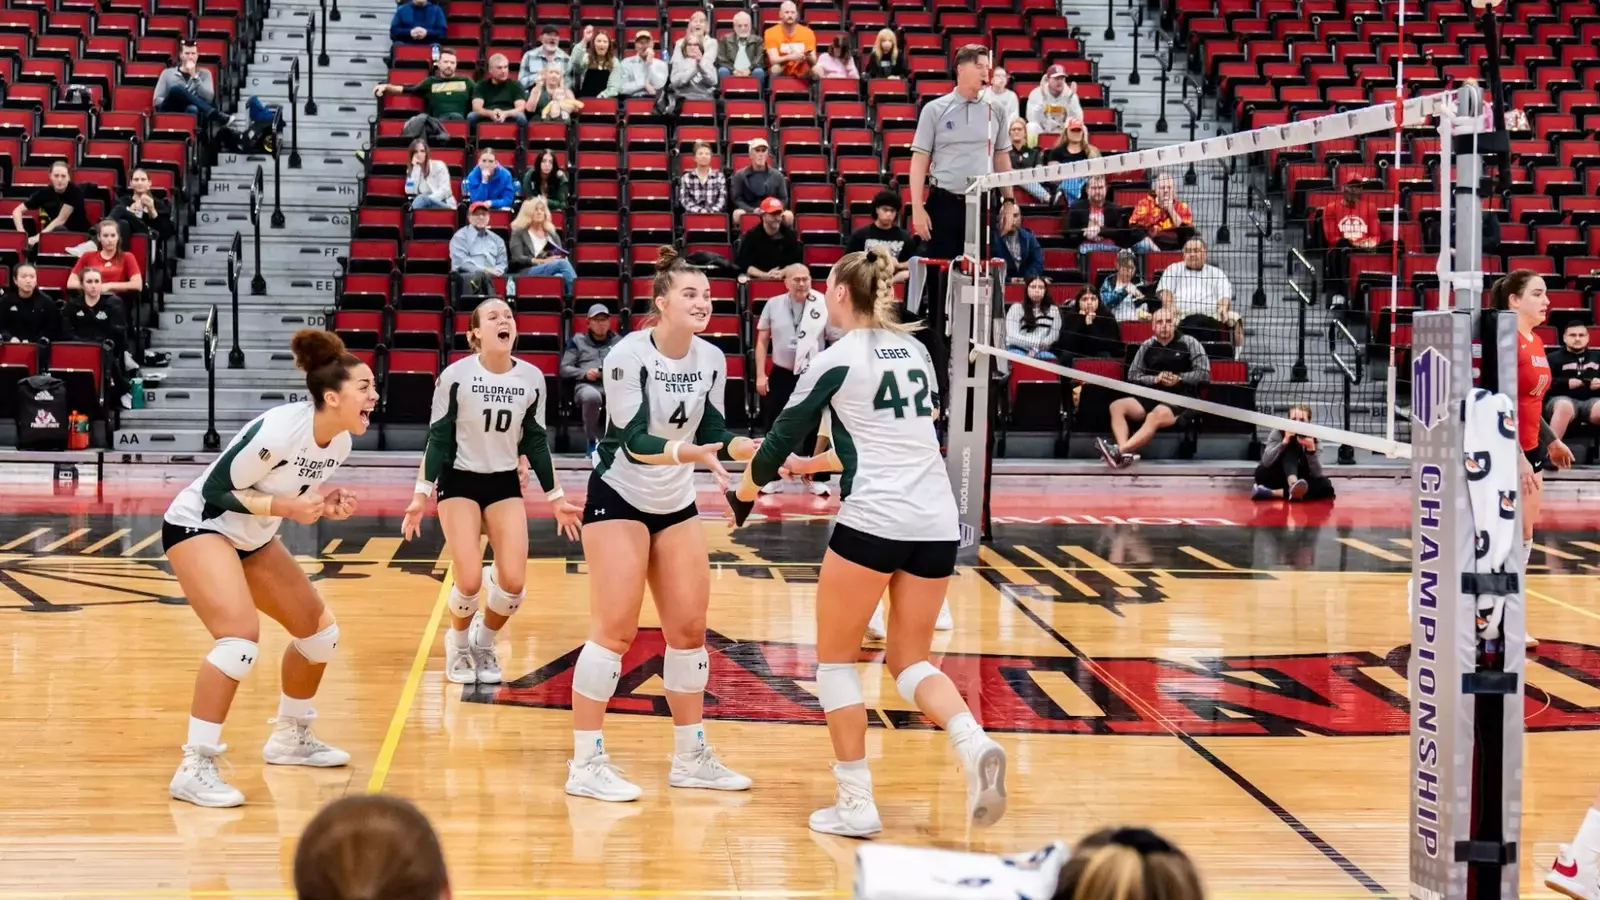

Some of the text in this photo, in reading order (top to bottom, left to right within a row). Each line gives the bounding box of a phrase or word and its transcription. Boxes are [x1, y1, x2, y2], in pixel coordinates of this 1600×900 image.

[213, 183, 230, 192] HH
[331, 215, 350, 225] GG
[193, 245, 209, 254] FF
[324, 247, 339, 257] FF
[180, 278, 197, 289] EE
[315, 280, 333, 291] EE
[307, 316, 326, 327] DD
[874, 347, 912, 360] LEBER
[471, 384, 525, 396] COLORADO
[872, 368, 933, 420] 42
[483, 394, 514, 404] STATE
[668, 400, 689, 429] 4
[482, 408, 513, 433] 10
[119, 433, 140, 445] AA
[961, 447, 971, 477] sports
[1417, 463, 1443, 861] CHAMPIONSHIP
